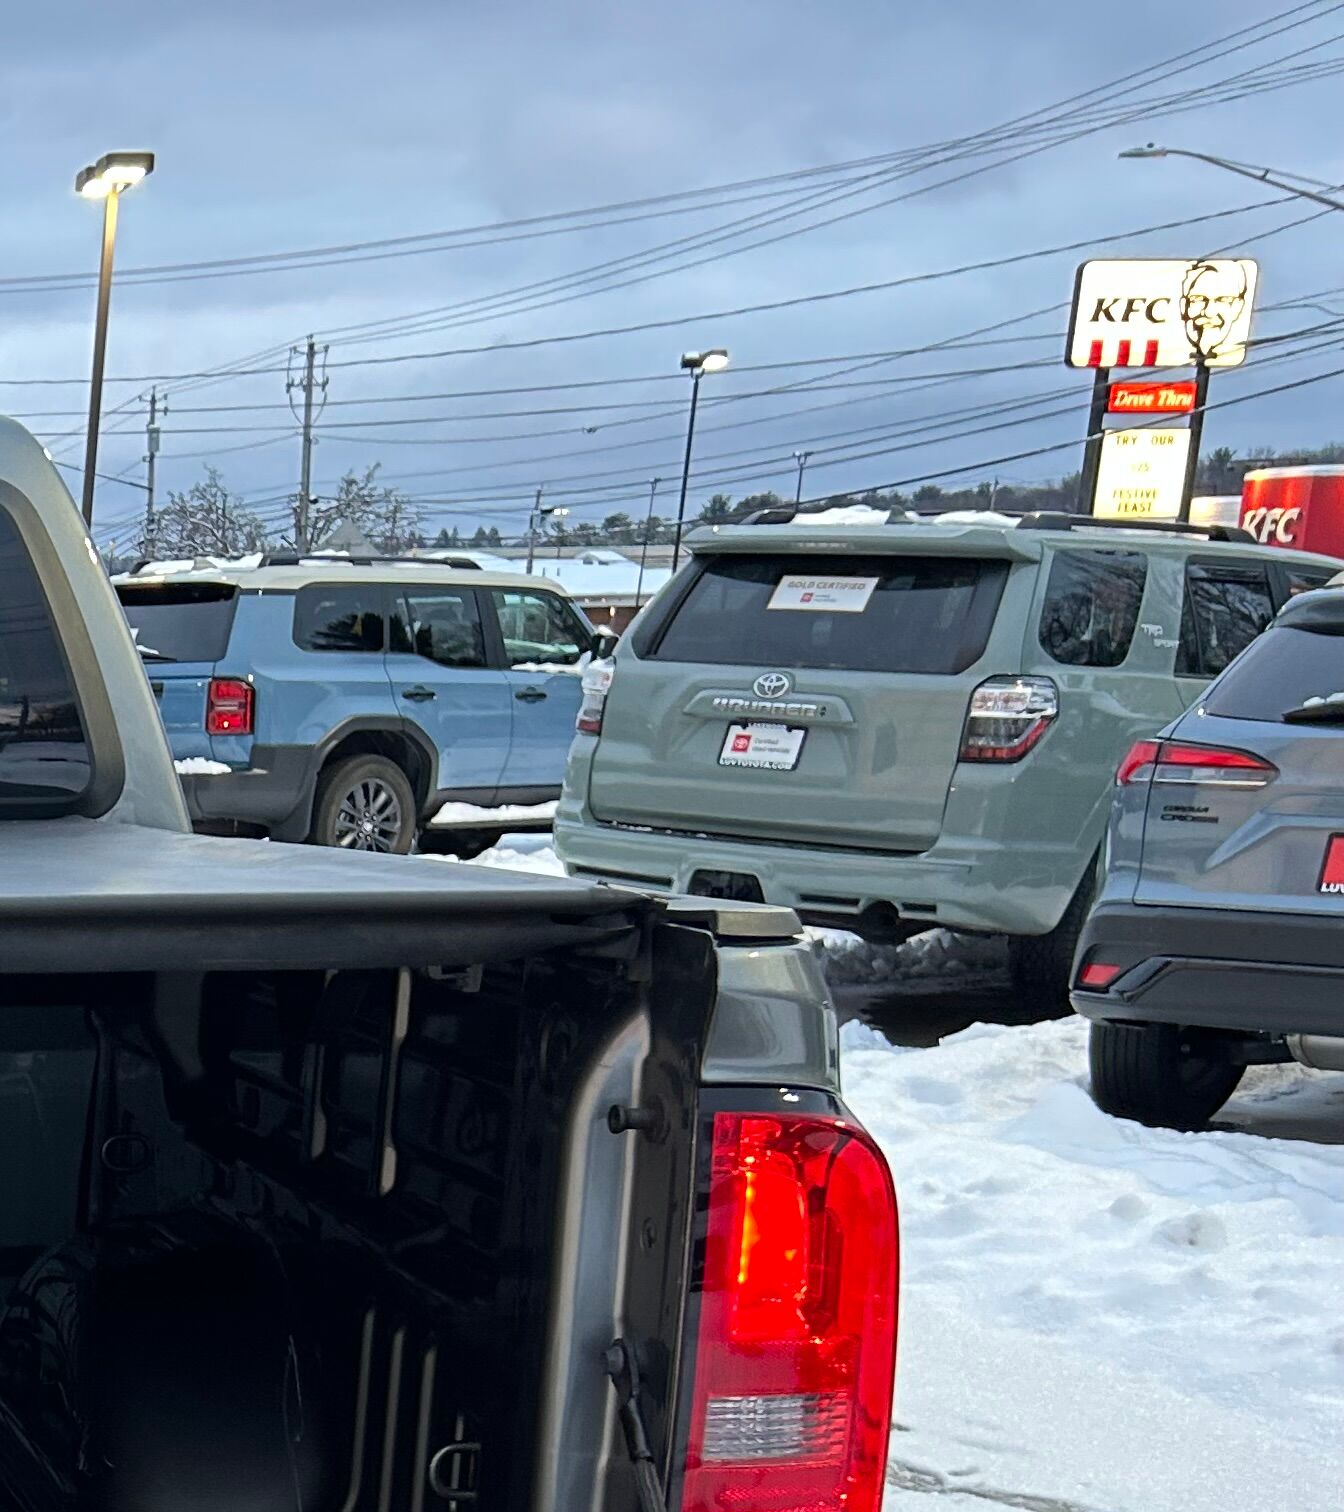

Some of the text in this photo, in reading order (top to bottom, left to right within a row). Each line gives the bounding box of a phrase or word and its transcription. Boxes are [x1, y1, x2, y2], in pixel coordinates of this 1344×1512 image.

[1090, 298, 1171, 323] KFC
[1157, 390, 1192, 406] Thru
[1116, 436, 1174, 445] TRY OUR
[1113, 490, 1157, 499] FESTIVE
[1118, 503, 1152, 513] FEAST
[1242, 507, 1302, 543] KFC
[787, 581, 866, 590] GOLD CERTIFIED
[1160, 814, 1219, 823] CROSS
